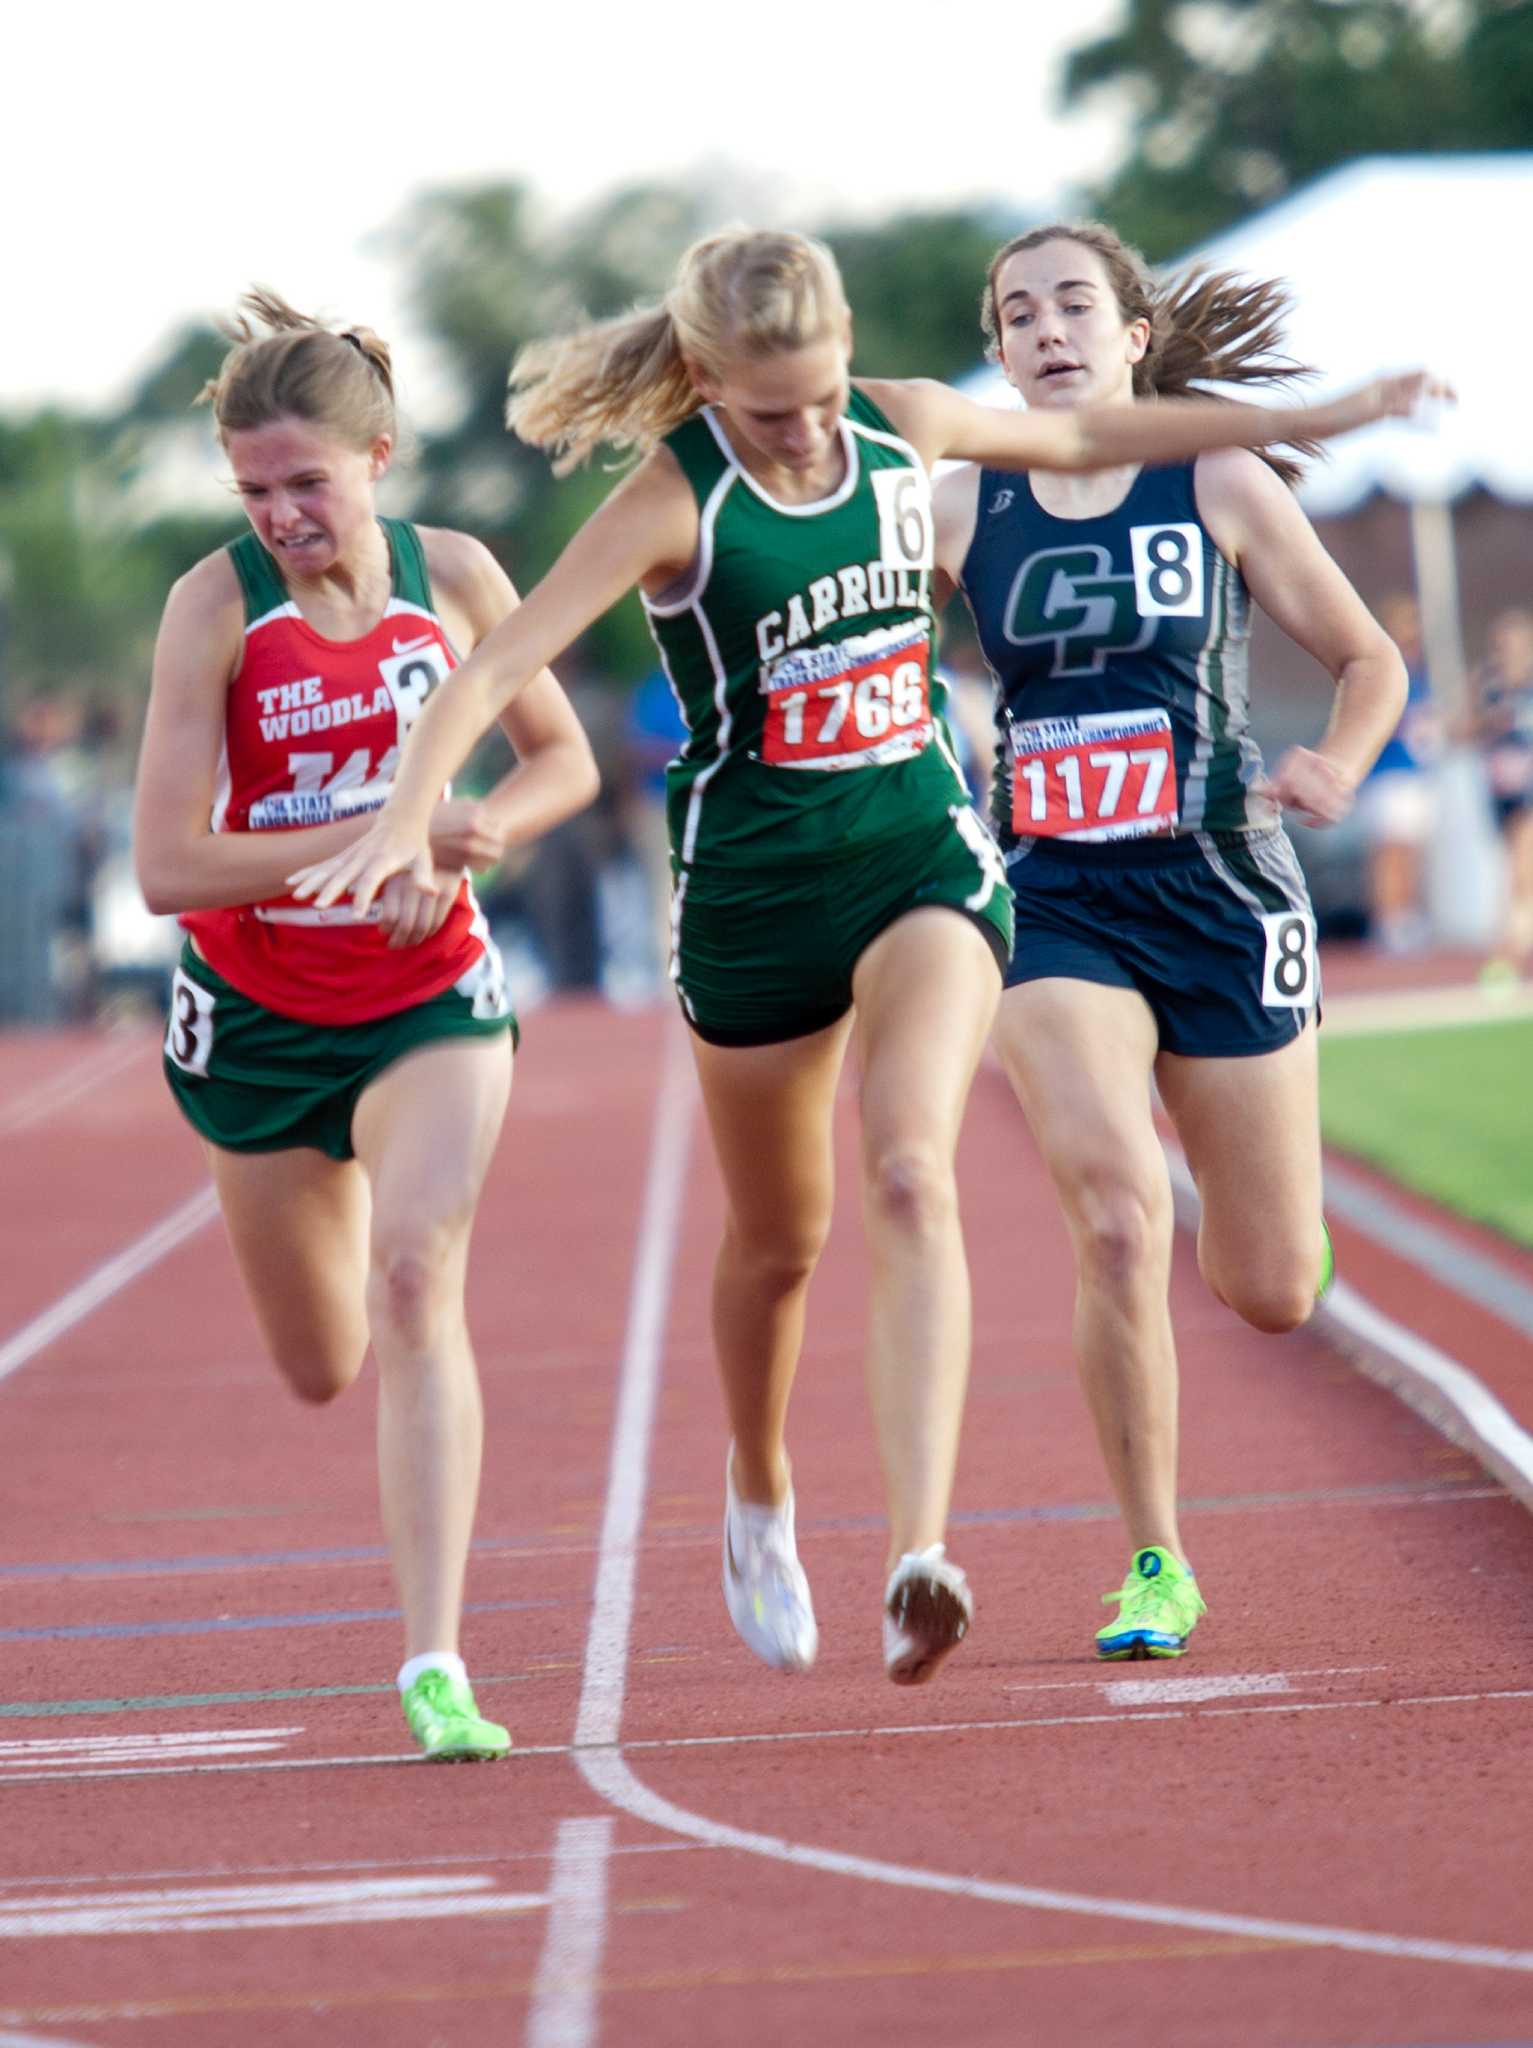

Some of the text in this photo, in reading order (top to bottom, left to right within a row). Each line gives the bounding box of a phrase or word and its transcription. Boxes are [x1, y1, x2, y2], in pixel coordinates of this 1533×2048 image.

[893, 475, 925, 562] 6
[1147, 529, 1193, 607] 8
[256, 676, 323, 715] THE
[258, 686, 395, 743] WOODLA
[779, 661, 923, 745] 1766
[1022, 748, 1169, 822] 1177
[1273, 918, 1308, 996] 8
[173, 985, 199, 1064] 3
